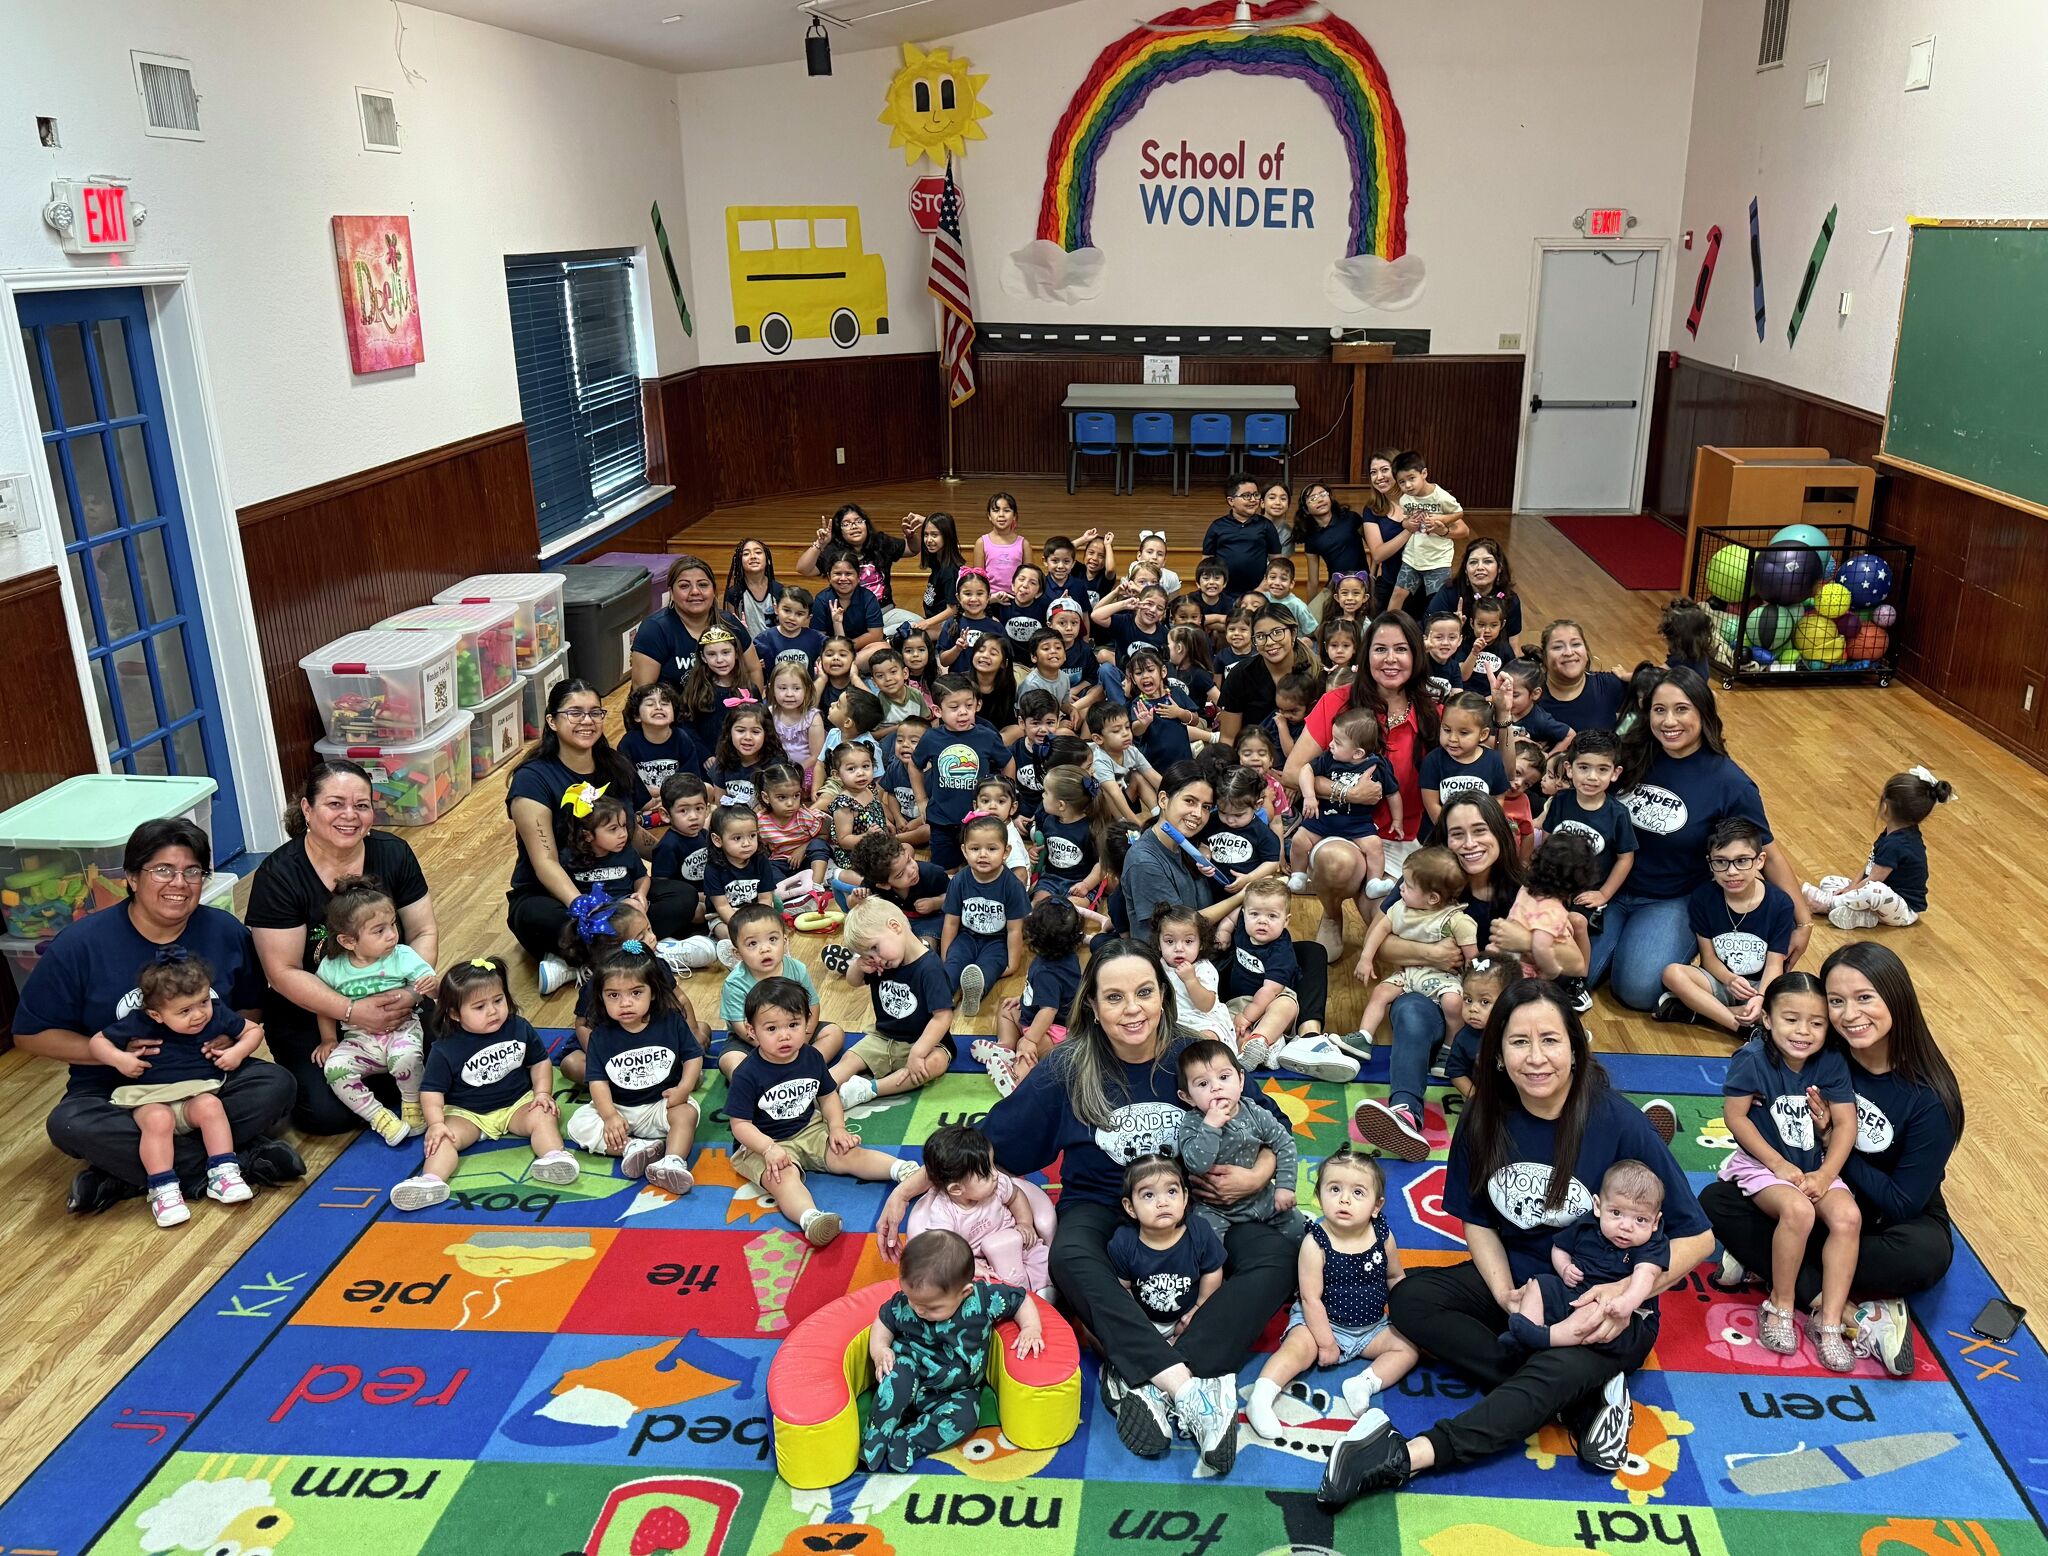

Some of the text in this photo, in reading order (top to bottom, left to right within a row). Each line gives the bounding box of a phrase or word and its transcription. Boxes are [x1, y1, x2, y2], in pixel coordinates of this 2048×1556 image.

[1140, 139, 1286, 181] School of
[83, 187, 127, 243] EXIT
[1139, 184, 1314, 229] WONDER
[1592, 210, 1622, 235] EXIT
[1008, 620, 1038, 635] WONDER
[777, 653, 806, 665] WONDER
[726, 783, 754, 796] WONDE
[894, 787, 916, 802] WOND
[1441, 781, 1485, 791] WONDER
[1634, 787, 1682, 812] ONDER
[684, 852, 709, 868] WOND
[726, 880, 760, 895] WONDE
[961, 903, 1003, 915] WONDER
[1714, 938, 1765, 952] WONDER
[465, 1042, 522, 1073] WONDER
[610, 1049, 669, 1069] WONDER
[763, 1081, 818, 1103] WONDER
[1108, 1112, 1184, 1133] WONDER
[1857, 1106, 1886, 1132] DER
[1497, 1170, 1581, 1203] WONR
[446, 1190, 562, 1223] box
[342, 1274, 453, 1313] pie
[646, 1263, 721, 1296] tie
[267, 1363, 471, 1423] red
[1738, 1385, 1878, 1422] pen
[628, 1414, 771, 1462] bed
[290, 1466, 441, 1500] ram
[904, 1491, 1064, 1529] man
[1107, 1509, 1230, 1556] fan
[1573, 1510, 1702, 1556] hat
